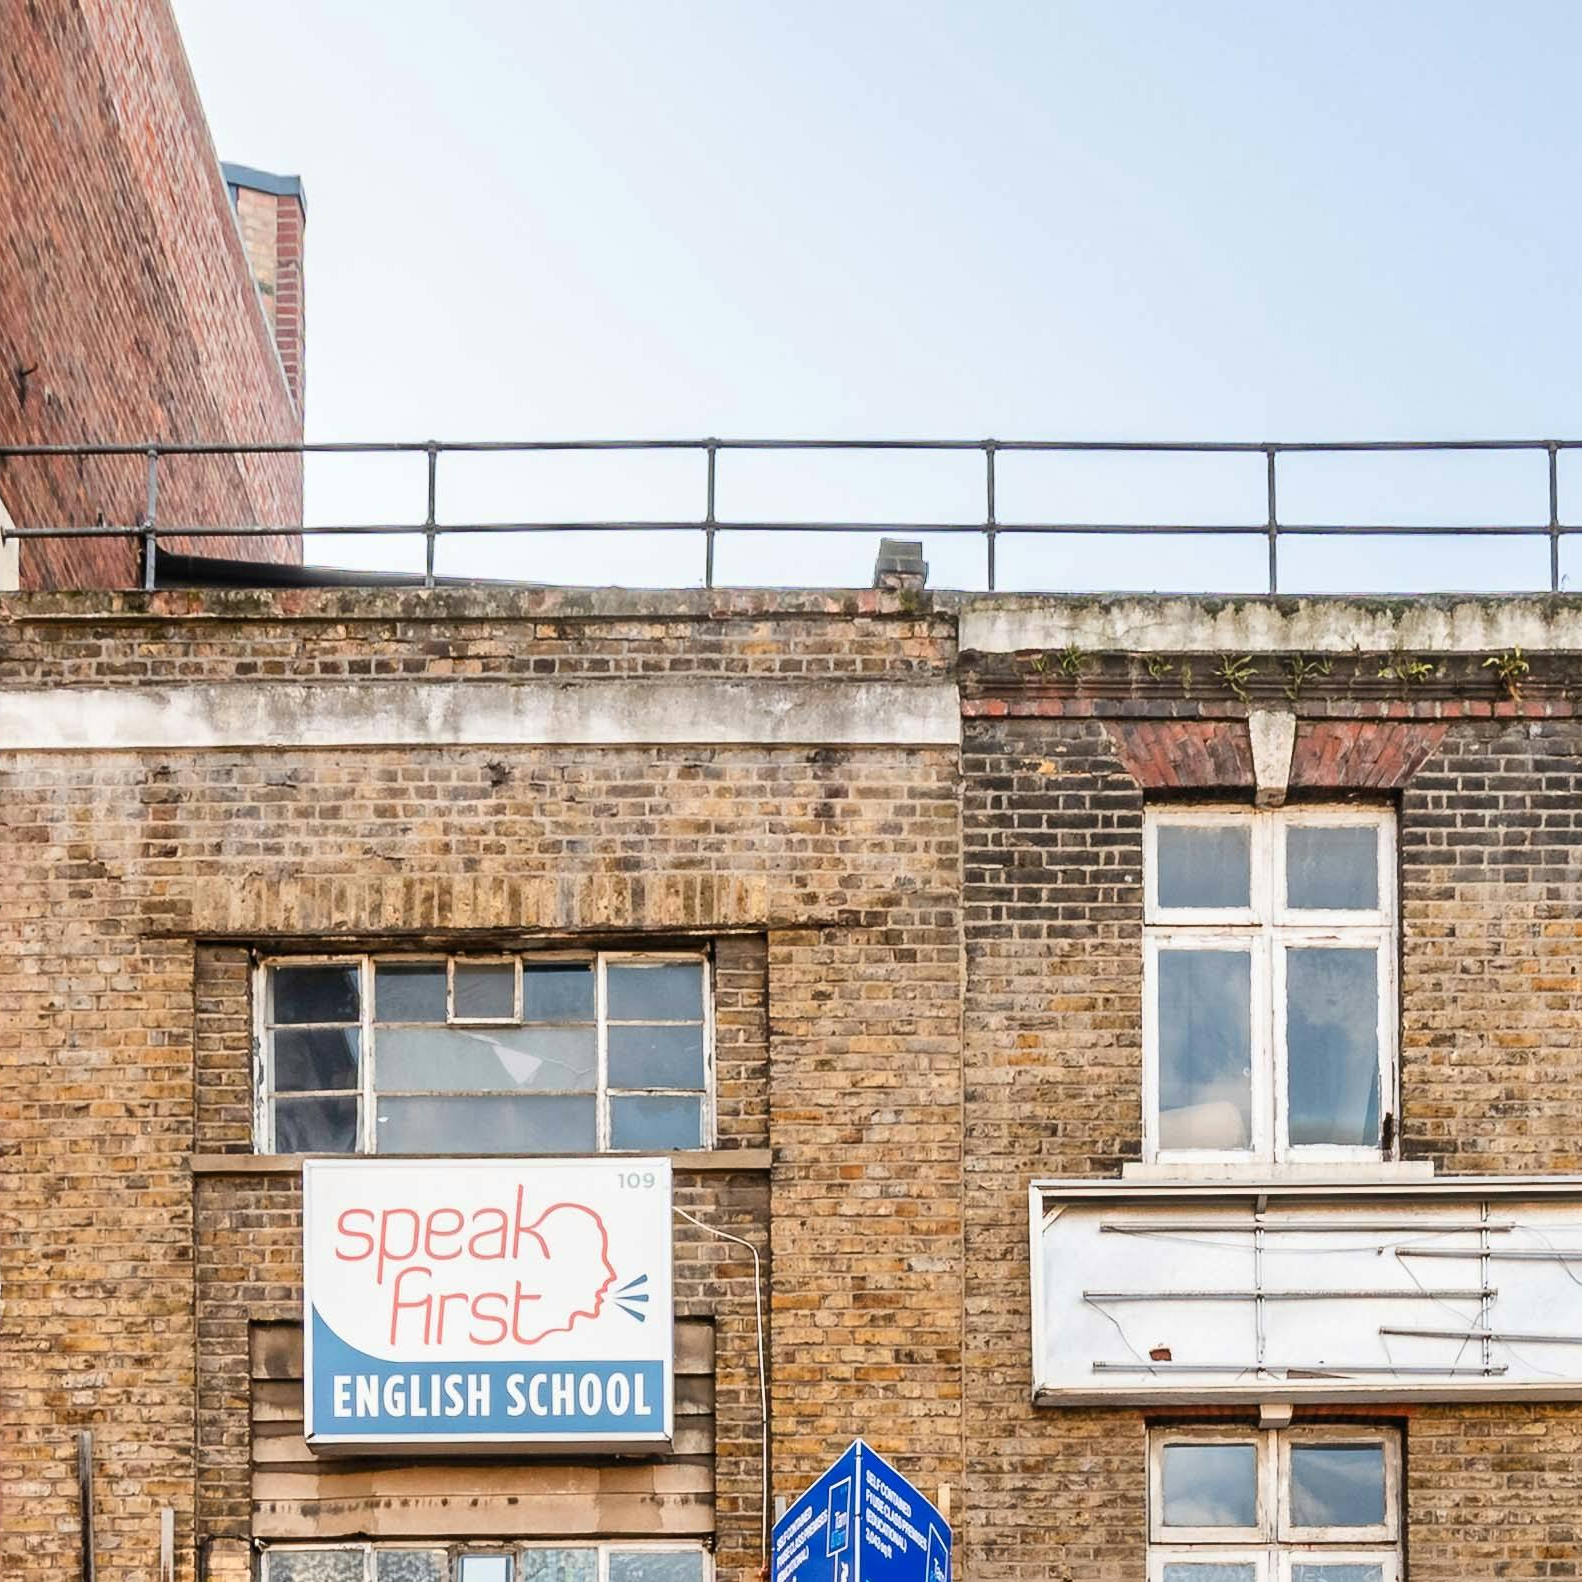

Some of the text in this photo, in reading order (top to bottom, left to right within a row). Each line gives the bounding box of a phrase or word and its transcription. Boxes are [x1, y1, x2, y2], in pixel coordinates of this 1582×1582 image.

[617, 1172, 657, 1191] 109
[334, 1184, 552, 1285] speak
[389, 1266, 543, 1348] first
[332, 1372, 652, 1419] ENGLISH SCHOOL
